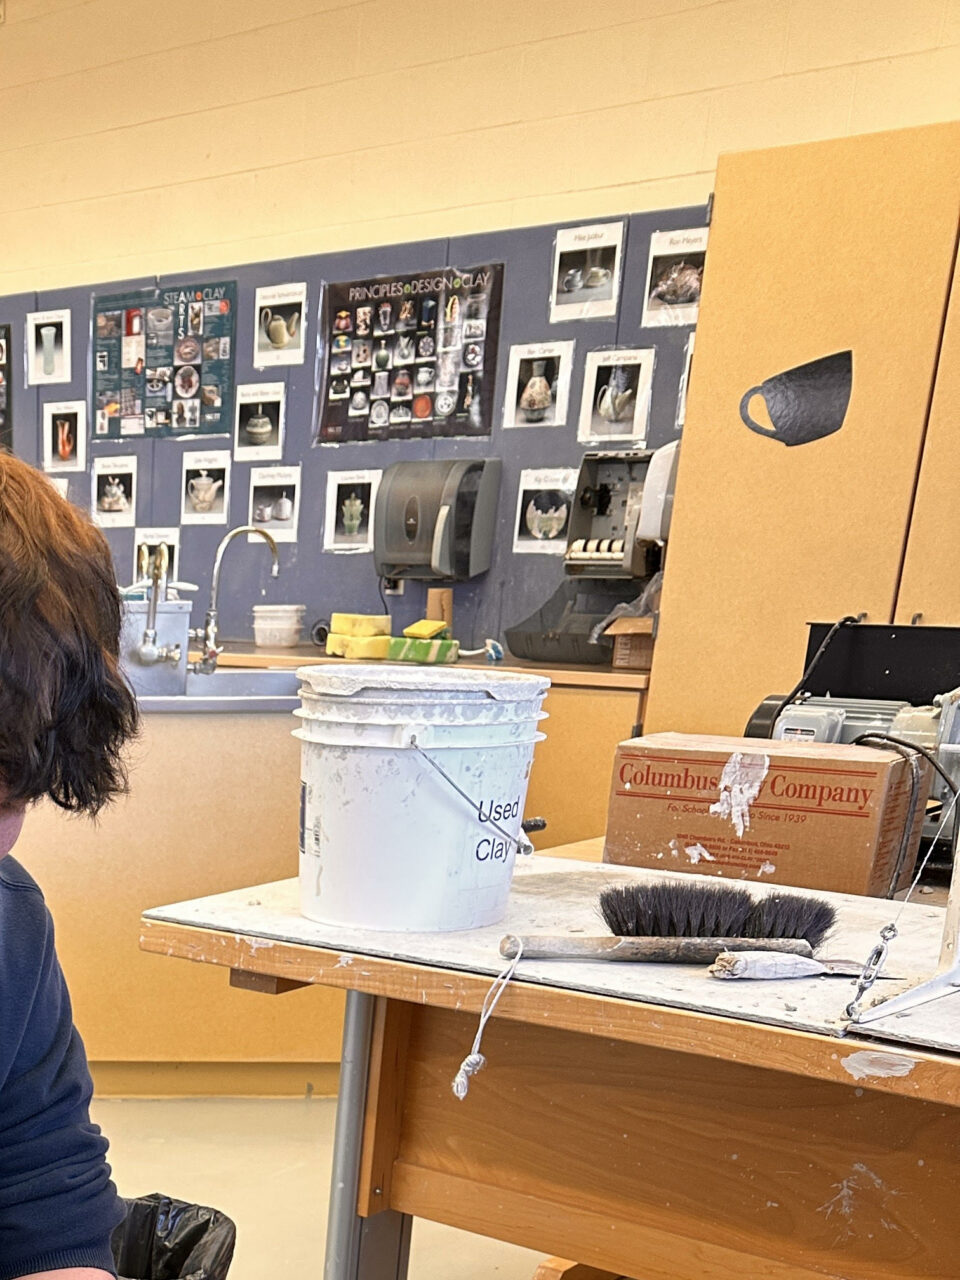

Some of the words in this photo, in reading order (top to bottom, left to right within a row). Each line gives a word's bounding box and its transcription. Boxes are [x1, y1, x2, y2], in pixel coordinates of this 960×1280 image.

[163, 290, 196, 305] STEAM
[202, 287, 227, 301] CLAY
[349, 281, 404, 301] PRINCIPLES
[411, 276, 453, 295] DESIGN
[461, 271, 491, 289] CLAY
[619, 763, 718, 791] Columbus
[770, 774, 874, 810] Company
[478, 795, 520, 823] Used
[758, 811, 780, 821] Since
[784, 812, 807, 824] 1939
[475, 838, 512, 863] Clay
